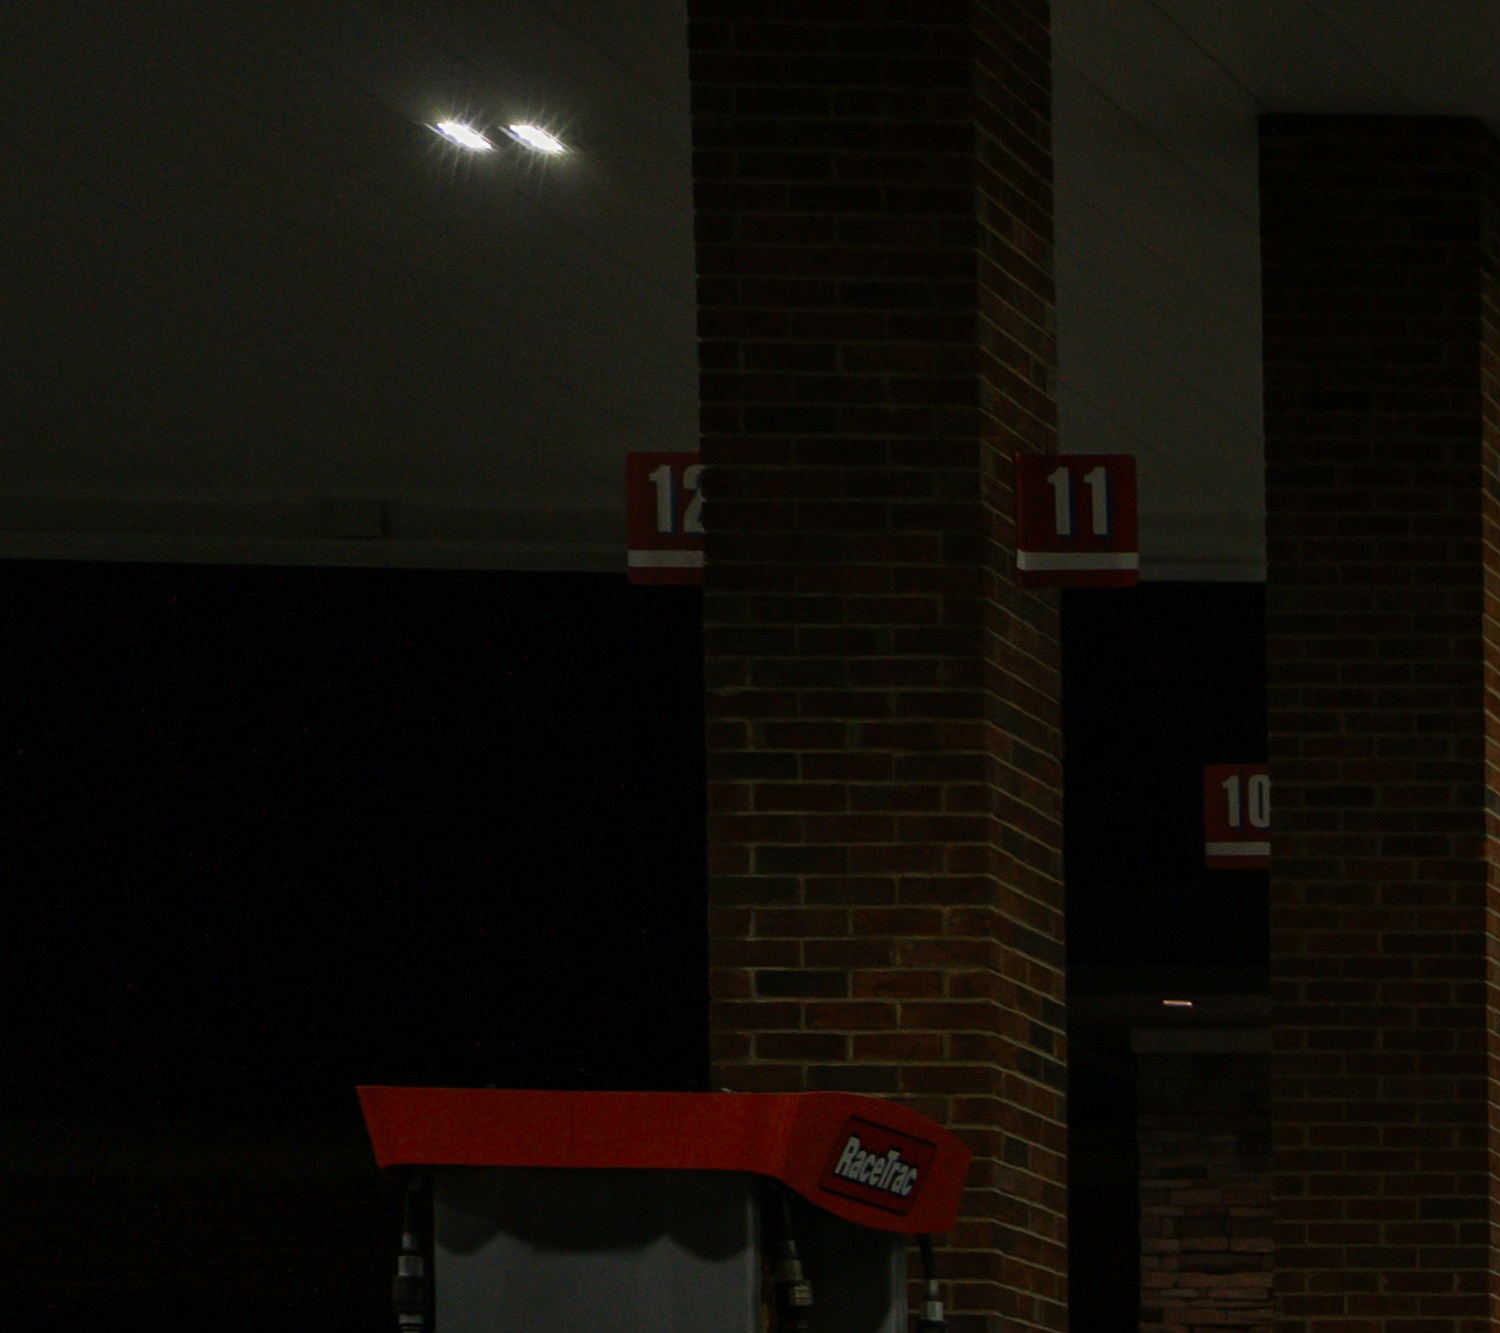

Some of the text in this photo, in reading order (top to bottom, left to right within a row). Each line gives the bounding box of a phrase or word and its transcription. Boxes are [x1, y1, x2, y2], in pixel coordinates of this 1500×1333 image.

[648, 463, 706, 533] 12
[1046, 465, 1109, 536] 11
[1221, 773, 1272, 828] 10
[833, 1135, 919, 1197] RaceTrac
